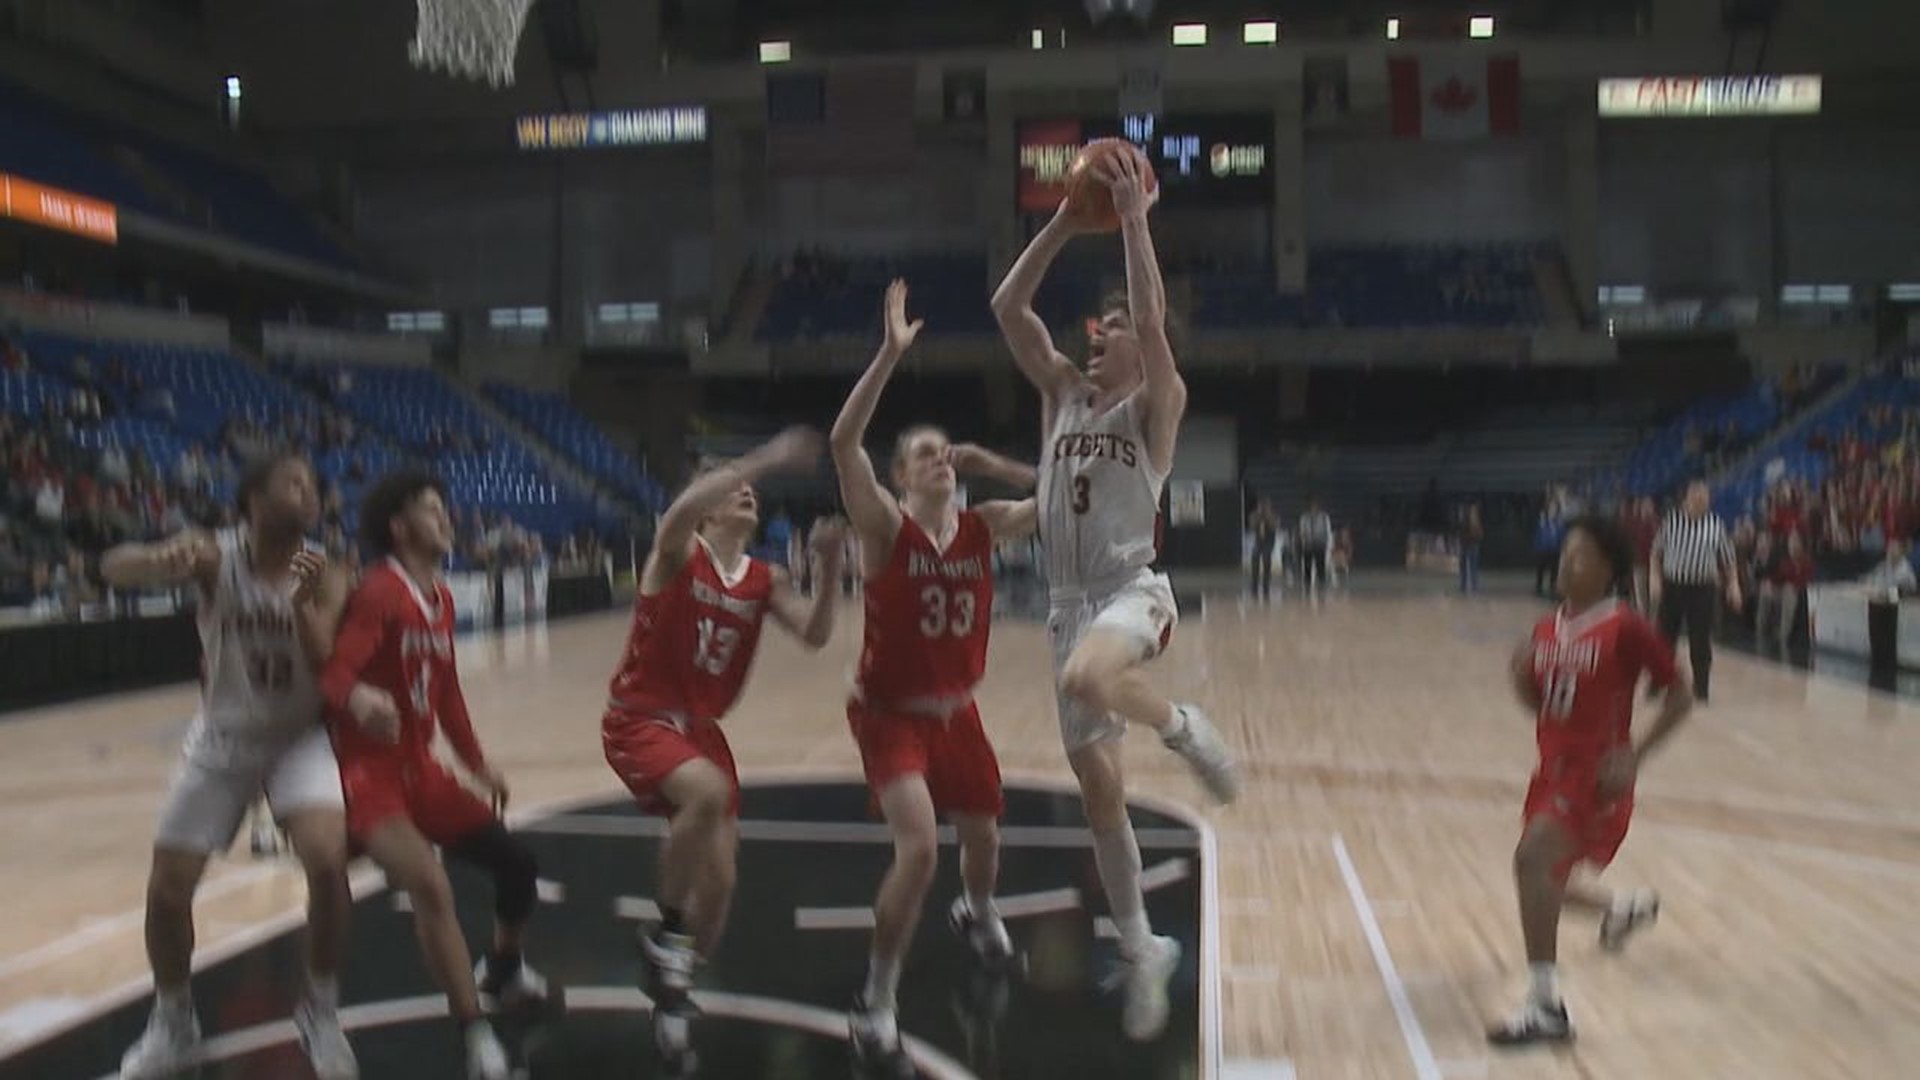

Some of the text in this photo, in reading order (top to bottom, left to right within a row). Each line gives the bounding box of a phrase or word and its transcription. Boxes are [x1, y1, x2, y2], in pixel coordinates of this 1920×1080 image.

[515, 115, 546, 149] VAN
[611, 109, 672, 144] DIAMOND
[673, 107, 707, 142] MINE
[1072, 474, 1091, 514] 3
[919, 584, 976, 639] 33
[693, 616, 741, 676] 13
